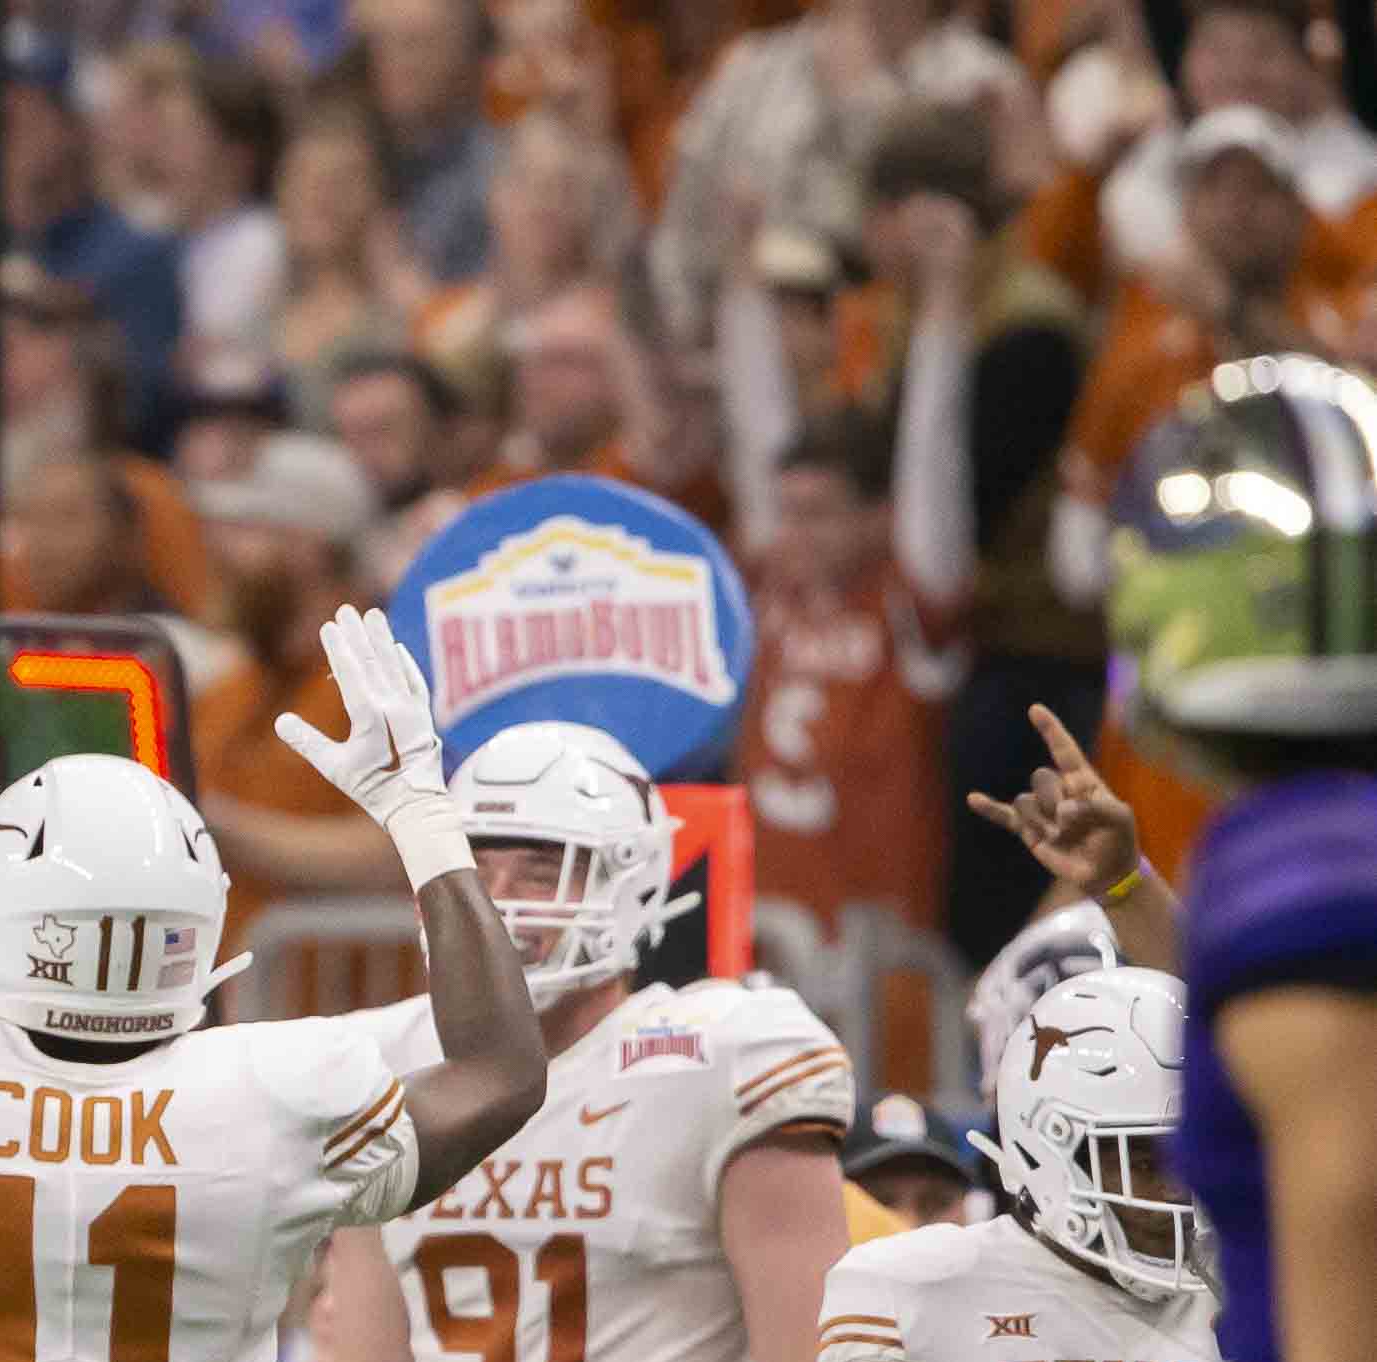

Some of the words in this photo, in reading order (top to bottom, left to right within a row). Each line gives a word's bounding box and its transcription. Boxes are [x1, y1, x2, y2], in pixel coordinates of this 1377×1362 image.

[96, 914, 145, 991] 11
[46, 1010, 174, 1033] LONGHORNS
[404, 1156, 613, 1219] XAS
